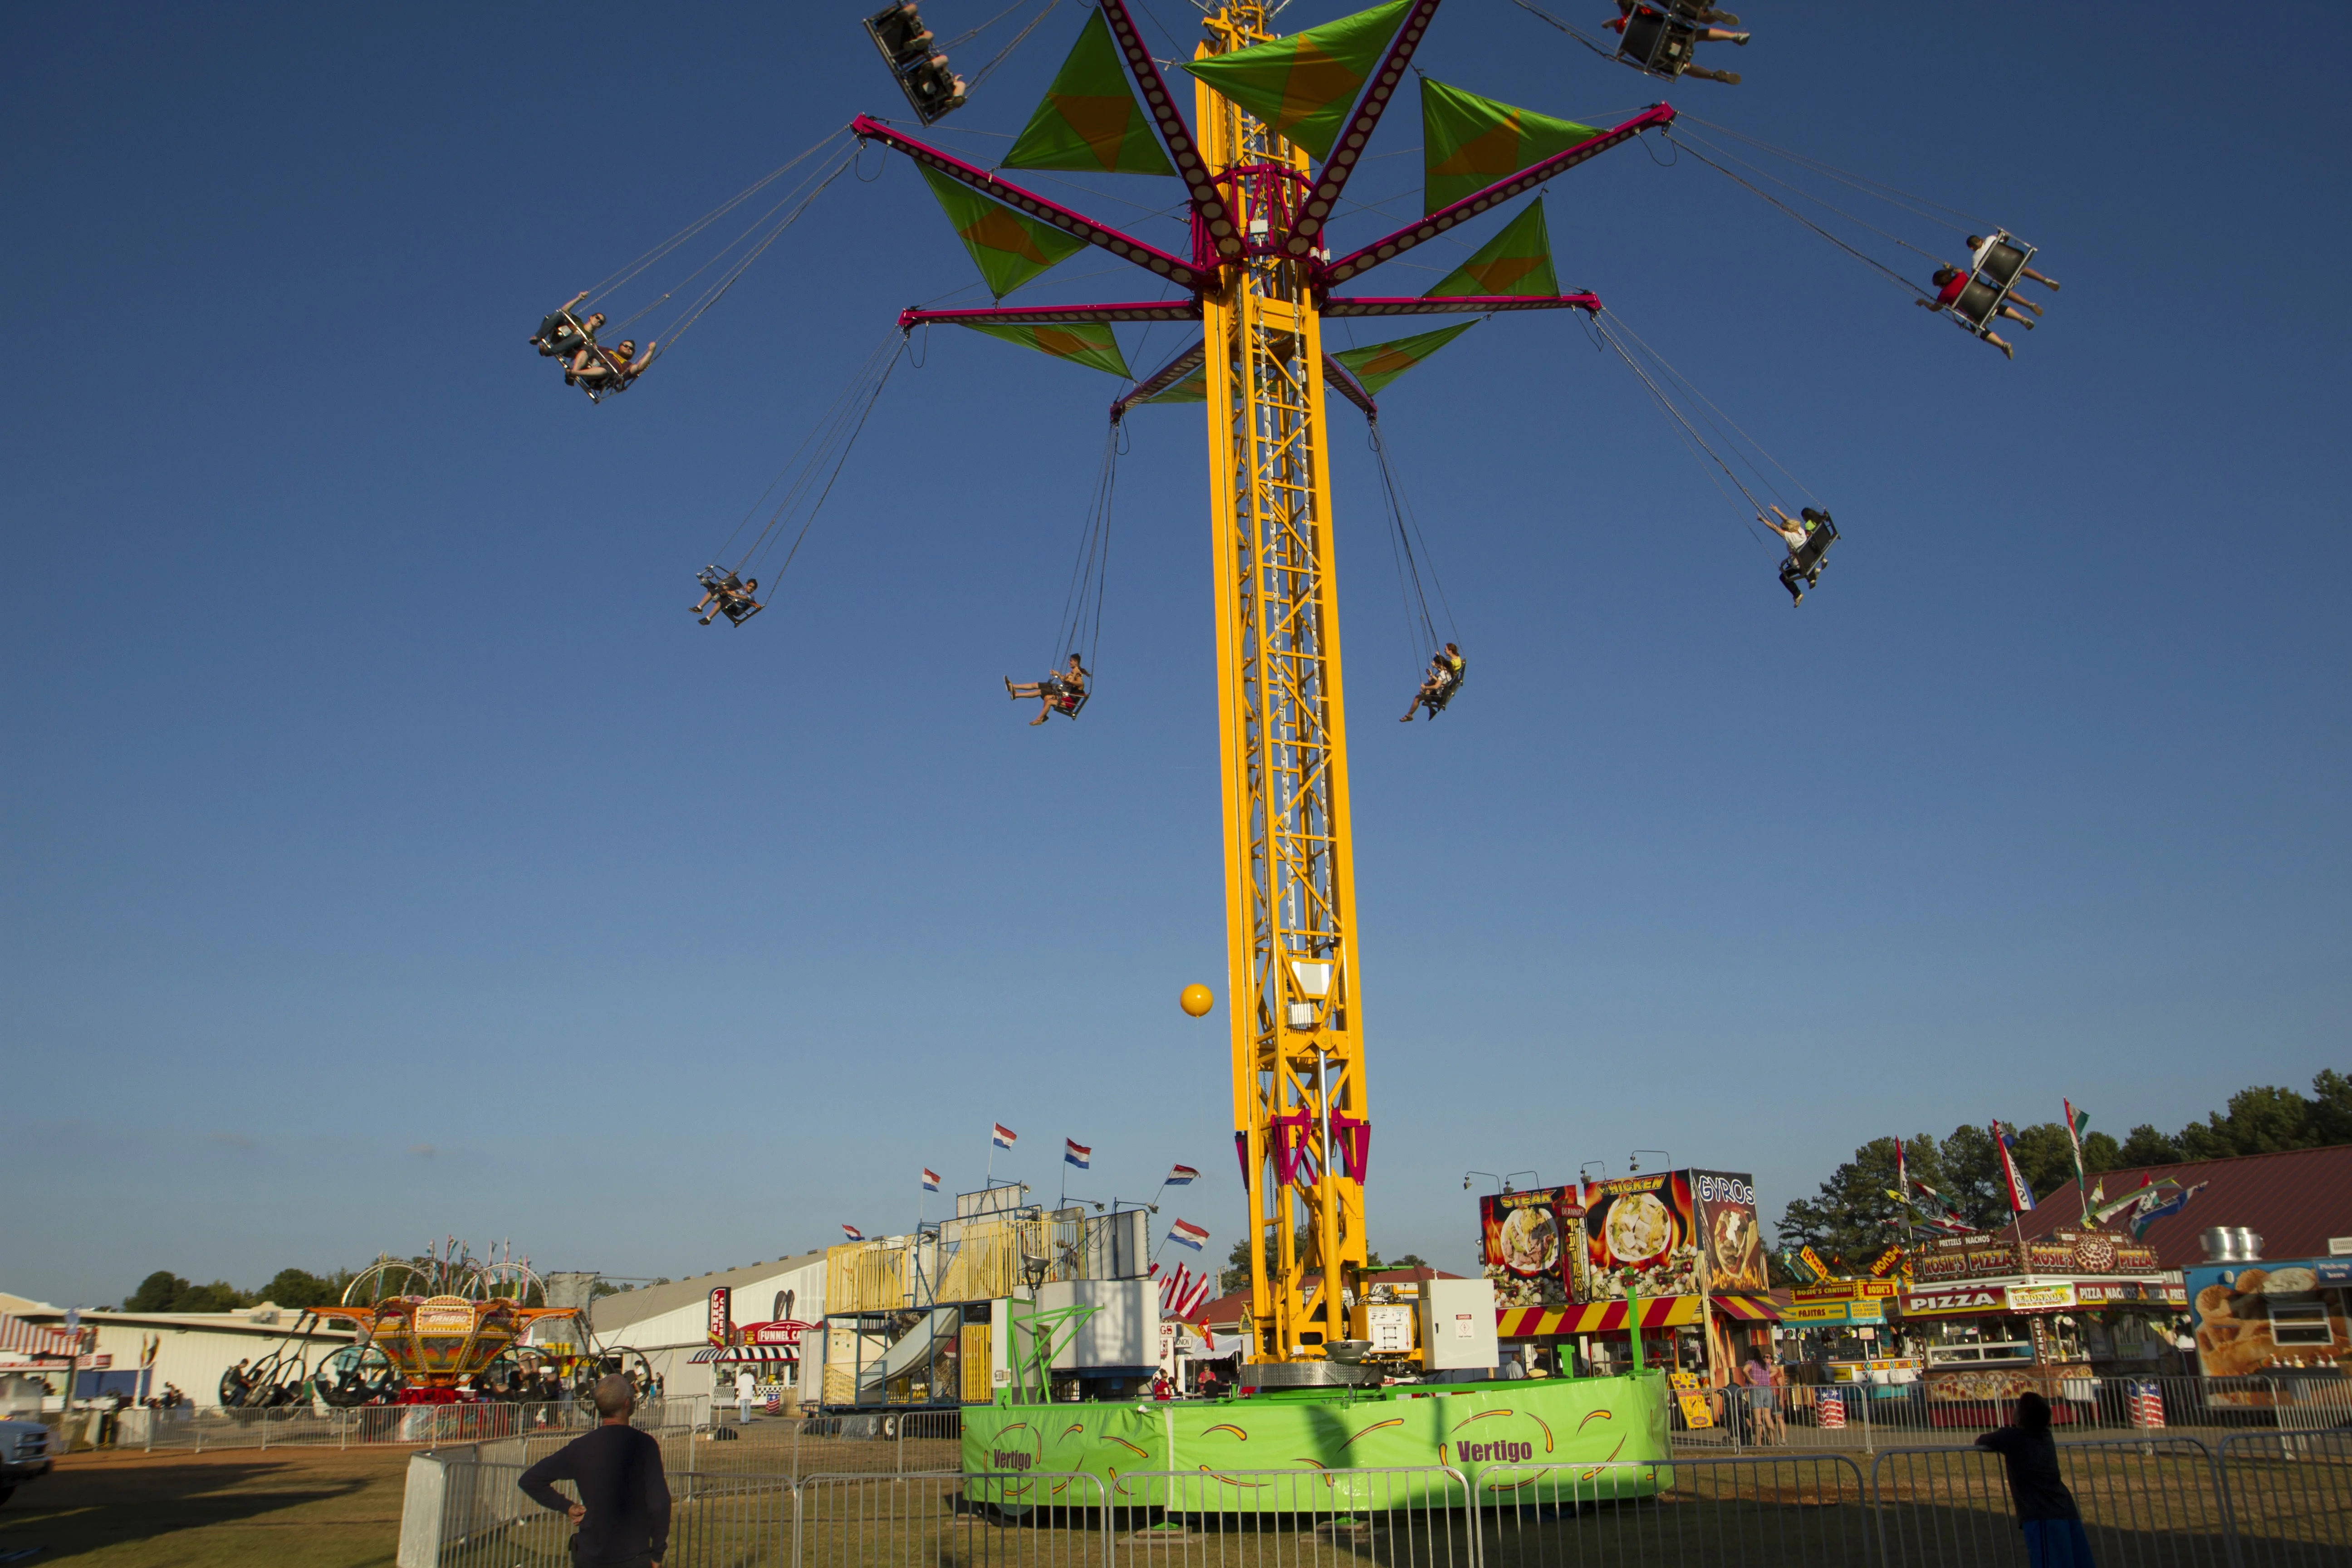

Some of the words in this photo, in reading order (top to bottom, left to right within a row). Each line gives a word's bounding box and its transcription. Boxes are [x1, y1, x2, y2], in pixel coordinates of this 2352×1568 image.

[1597, 1174, 1666, 1195] CHICKEN
[1501, 1189, 1557, 1208] STEAK
[1562, 1206, 1585, 1217] DEANNA'S
[1939, 1237, 1962, 1248] PRETZELS
[1965, 1235, 1990, 1245] NACHOS
[1922, 1253, 1966, 1276] ROSIE'S
[1968, 1249, 2013, 1271] PIZZA
[2032, 1246, 2075, 1268] ROSIE'S
[2117, 1250, 2155, 1269] PIZZA
[1824, 1286, 1852, 1294] CANTINA
[1867, 1285, 1891, 1294] ROSIE'S
[2079, 1287, 2102, 1299] PIZZA
[2104, 1287, 2137, 1300] NACHOS
[2148, 1288, 2168, 1300] PIZZA
[1910, 1293, 1996, 1311] PIZZA
[2012, 1293, 2063, 1303] LEMONADE
[1798, 1308, 1826, 1318] FAJITAS
[760, 1331, 789, 1340] FUNNEL
[1456, 1440, 1532, 1463] Vertigo
[994, 1449, 1031, 1472] Vertigo
